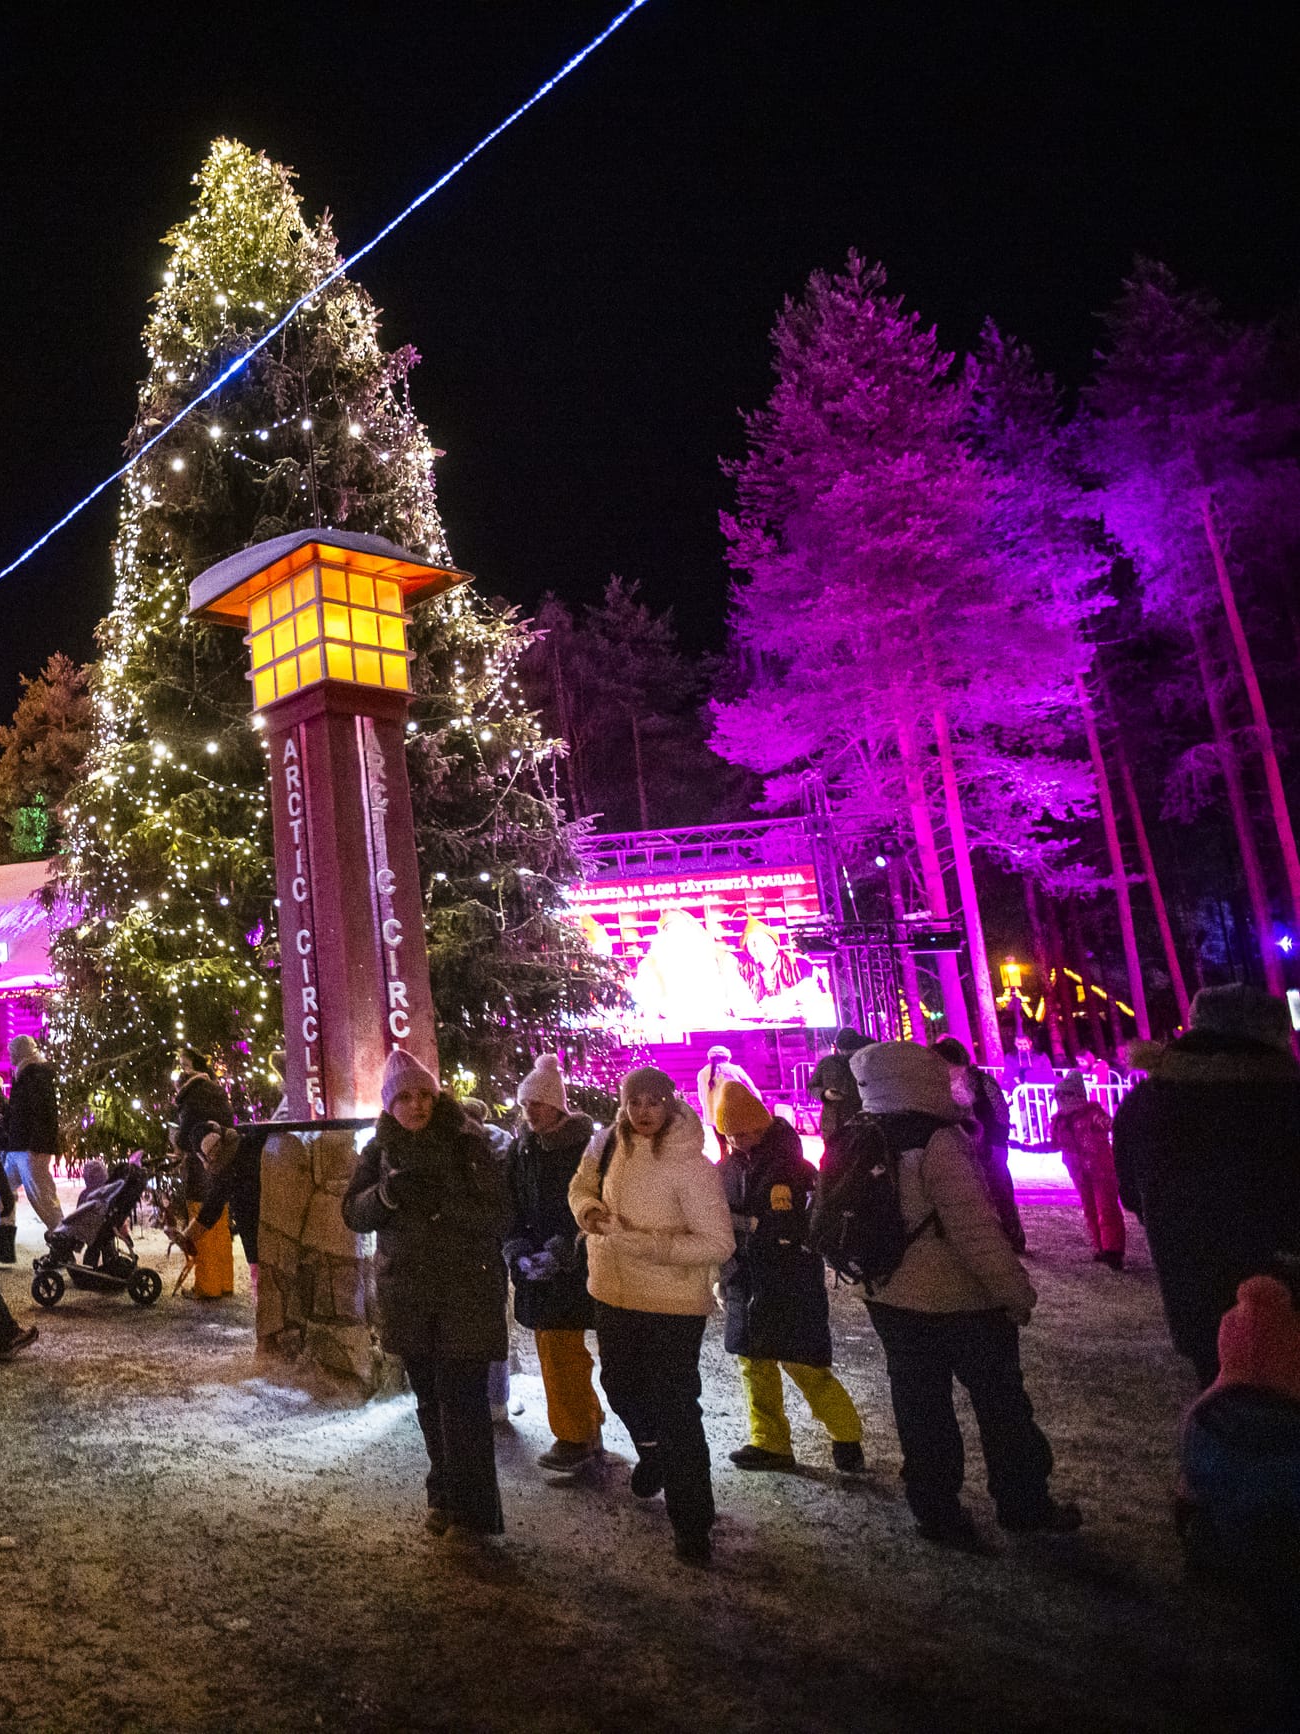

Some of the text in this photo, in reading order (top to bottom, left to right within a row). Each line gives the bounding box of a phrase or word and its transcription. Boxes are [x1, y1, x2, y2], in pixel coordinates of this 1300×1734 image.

[283, 738, 321, 1104] ARCTIC CIRCLE
[752, 873, 806, 890] JOULUA
[382, 919, 410, 1051] CIRC
